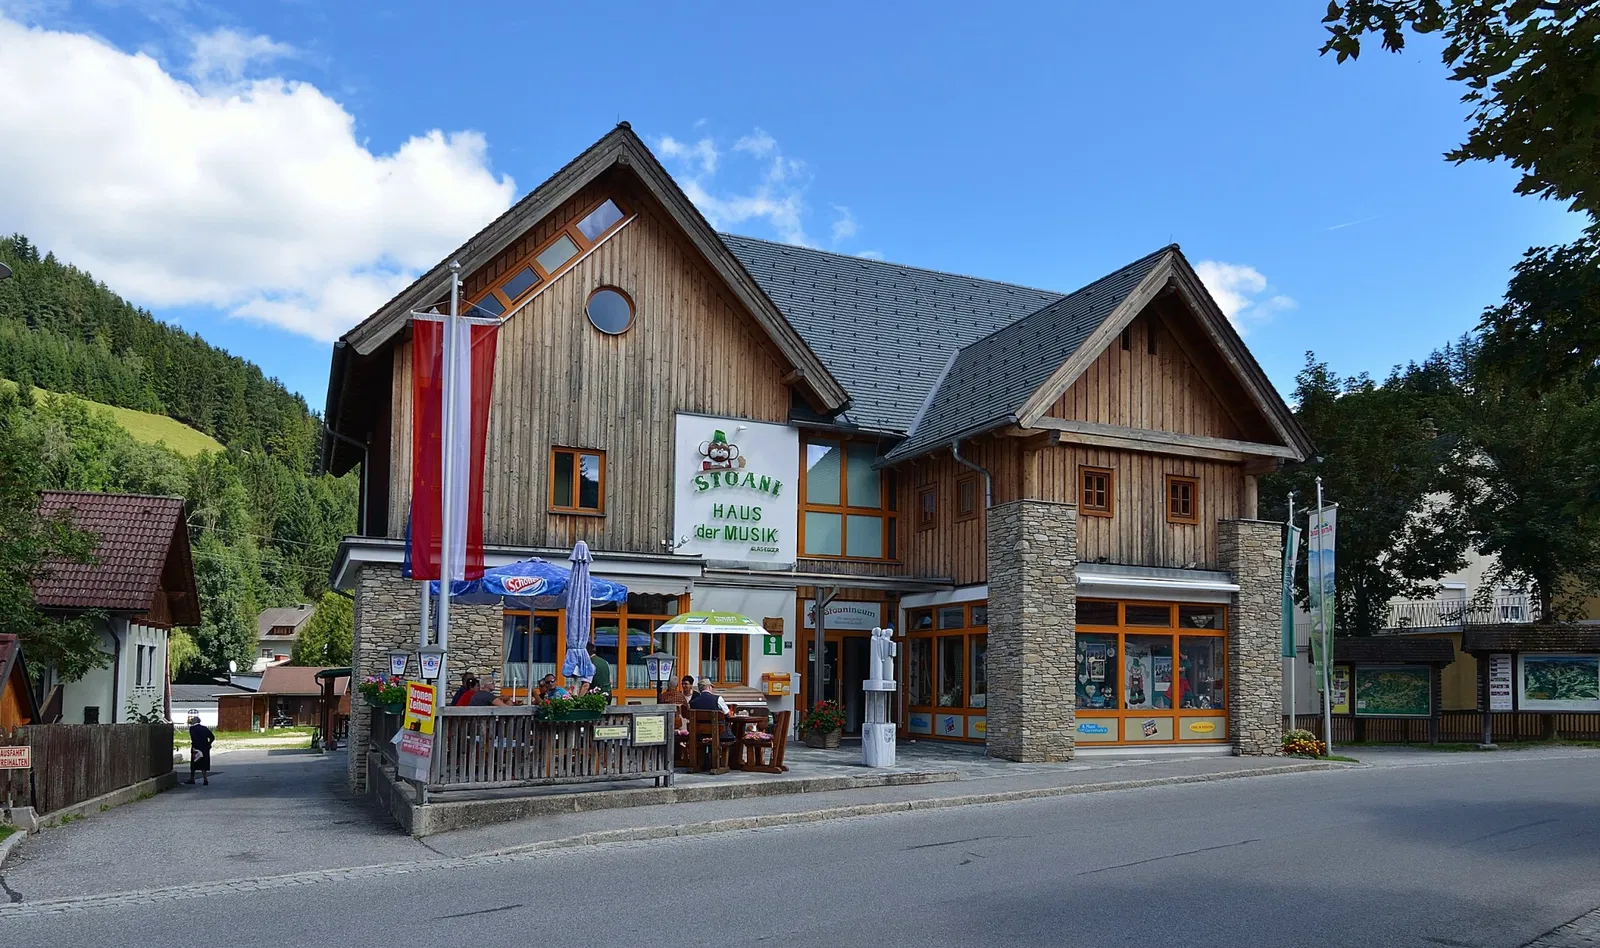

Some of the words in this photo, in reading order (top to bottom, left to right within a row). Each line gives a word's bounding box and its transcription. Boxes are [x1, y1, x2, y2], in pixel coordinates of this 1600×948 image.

[694, 471, 783, 496] STOANI
[713, 503, 762, 521] HAUS
[696, 524, 720, 539] der
[724, 525, 779, 543] MUSIK
[410, 686, 433, 702] Kronen
[409, 698, 432, 715] Zeitung
[0, 749, 26, 757] AUSFAHRT
